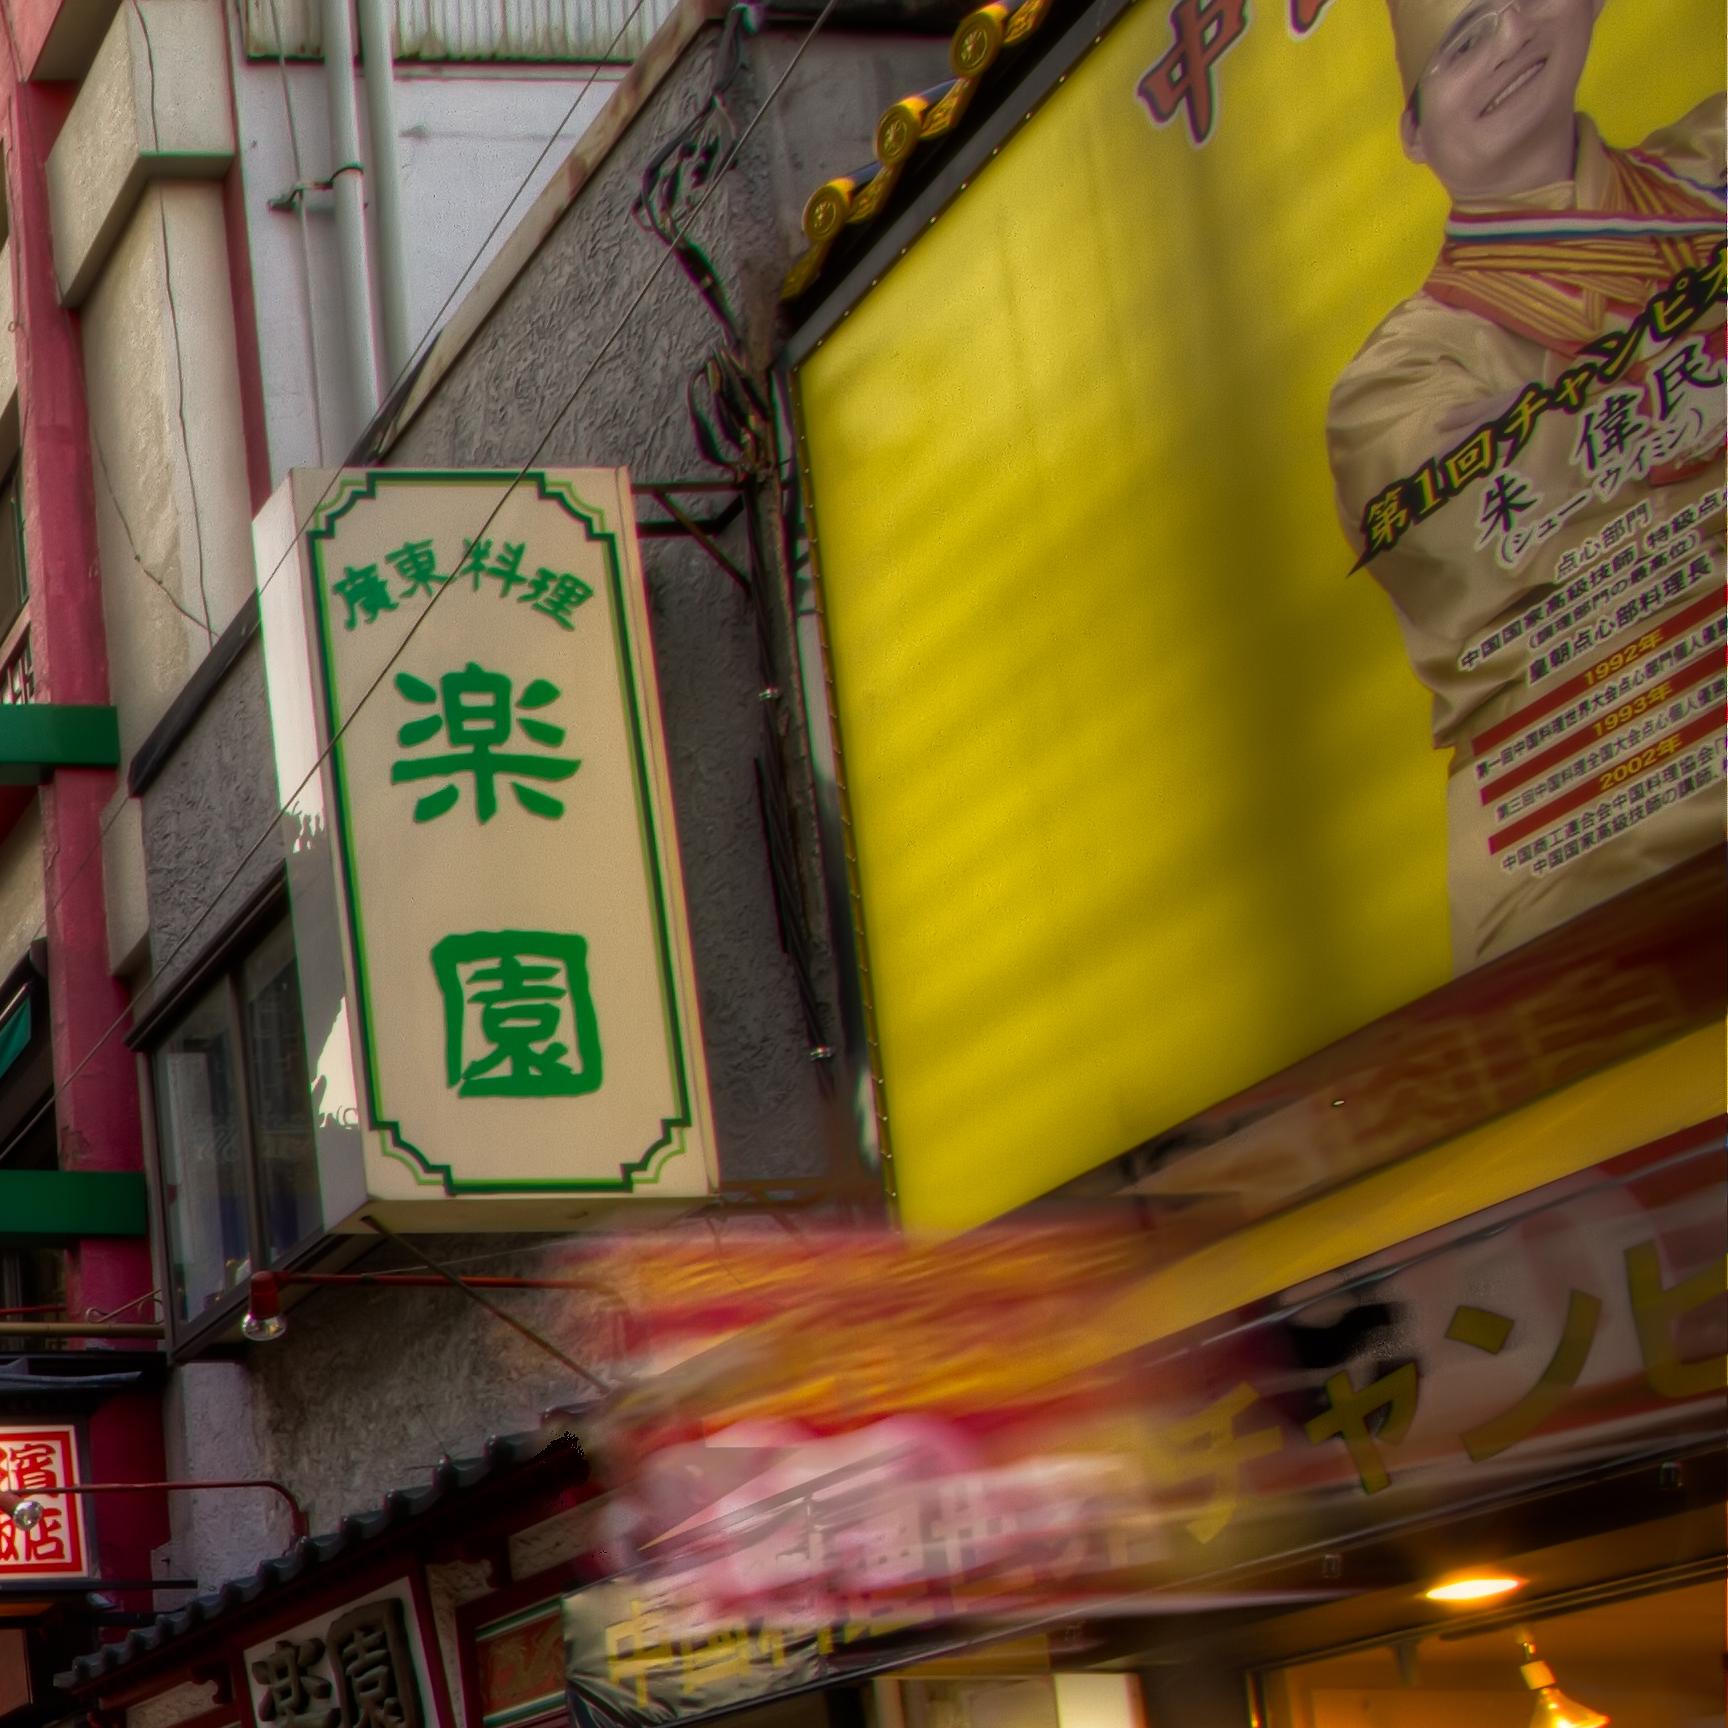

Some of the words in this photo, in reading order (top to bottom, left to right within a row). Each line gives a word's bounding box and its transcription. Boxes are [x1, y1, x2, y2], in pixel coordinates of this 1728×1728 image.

[1558, 501, 1649, 579] 点心部門
[1648, 487, 1728, 549] 特級点
[332, 538, 594, 632] 廣東料理
[1584, 628, 1664, 686] 1992年
[1594, 681, 1673, 738] 1993年
[1599, 733, 1682, 791] 2002年
[392, 661, 603, 1099] 楽園
